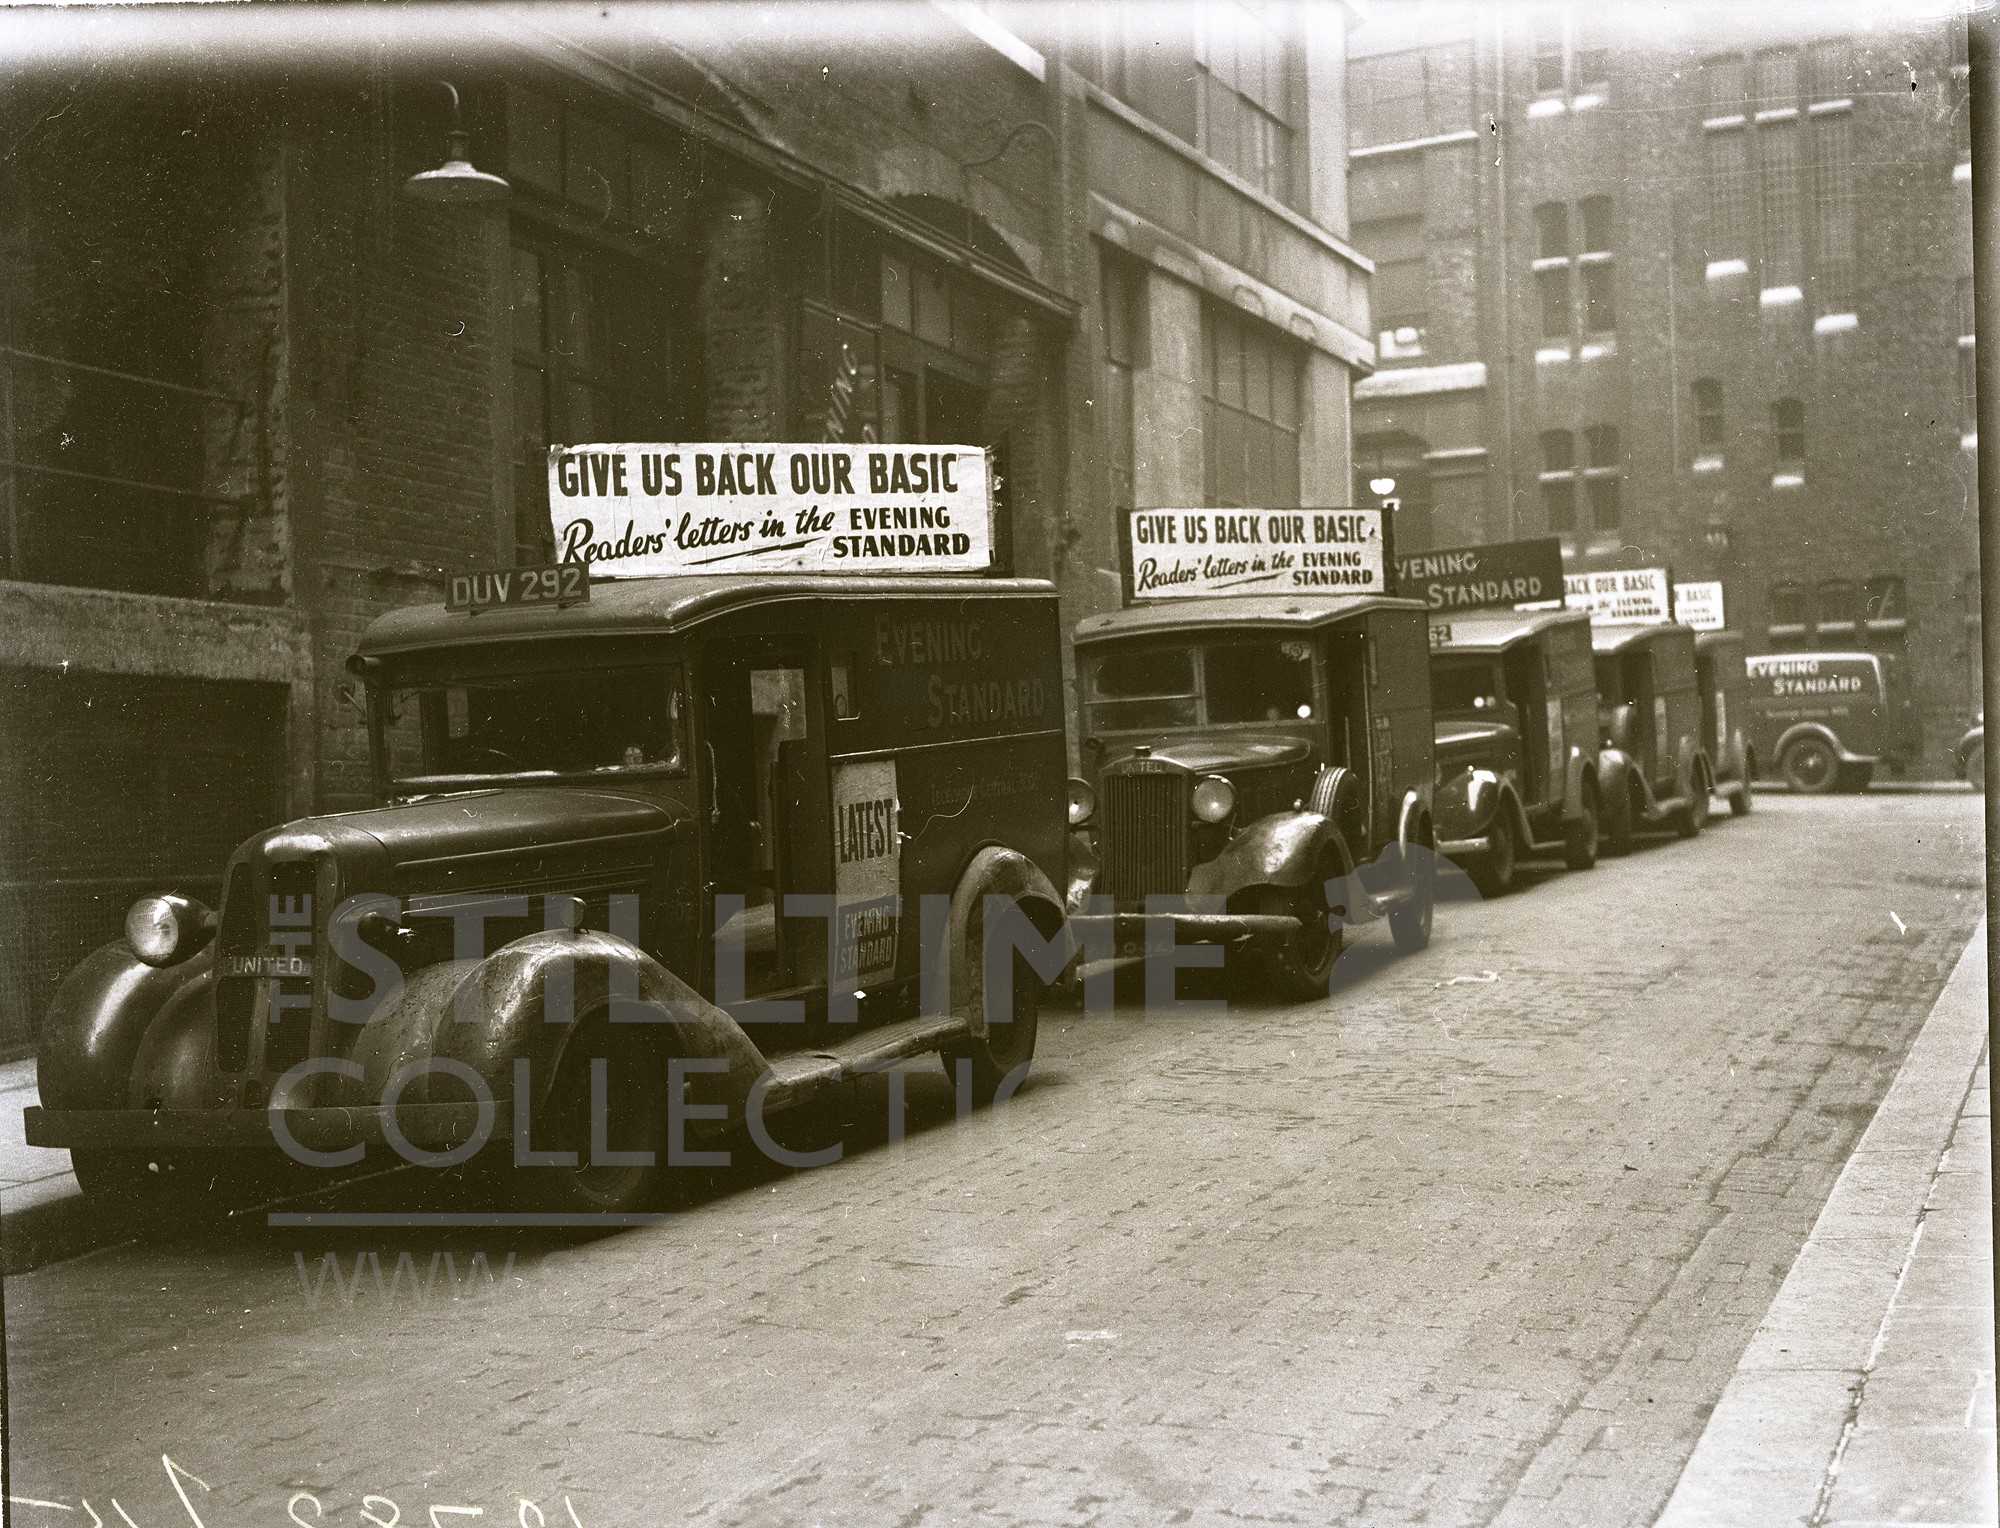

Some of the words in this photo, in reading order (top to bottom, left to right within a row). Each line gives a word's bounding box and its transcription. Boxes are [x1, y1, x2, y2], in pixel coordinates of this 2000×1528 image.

[558, 453, 628, 497] GIVE
[641, 454, 682, 496] US
[695, 452, 777, 496] BACK
[790, 452, 856, 496] OUR
[868, 452, 959, 494] BASIC
[850, 506, 951, 530] EVENING
[1136, 515, 1176, 544] GIVE
[1184, 516, 1208, 544] US
[1215, 515, 1261, 544] BACK
[1269, 516, 1306, 544] OUR
[1313, 515, 1366, 544] BASIC
[562, 517, 671, 564] Readers'
[672, 511, 755, 550] letters
[758, 510, 787, 538] in
[794, 505, 835, 535] the
[833, 533, 970, 558] STANDARD
[1137, 557, 1201, 592] Readers'
[1202, 554, 1247, 580] letters
[1251, 554, 1266, 573] in
[1272, 551, 1295, 569] the
[1302, 552, 1361, 567] EVENING
[1394, 552, 1476, 580] VENING
[452, 573, 511, 606] DUV
[520, 567, 582, 600] 292
[1292, 569, 1373, 586] STANDARD
[1427, 577, 1542, 609] STANDARD
[1623, 574, 1656, 591] BASIC
[875, 613, 983, 666] EVENING
[927, 673, 1045, 729] STANDARD
[1773, 677, 1862, 696] STANDARD
[838, 798, 893, 864] LATEST
[844, 905, 889, 941] EVENING
[232, 957, 303, 975] UNITED
[840, 936, 892, 974] STANDARD
